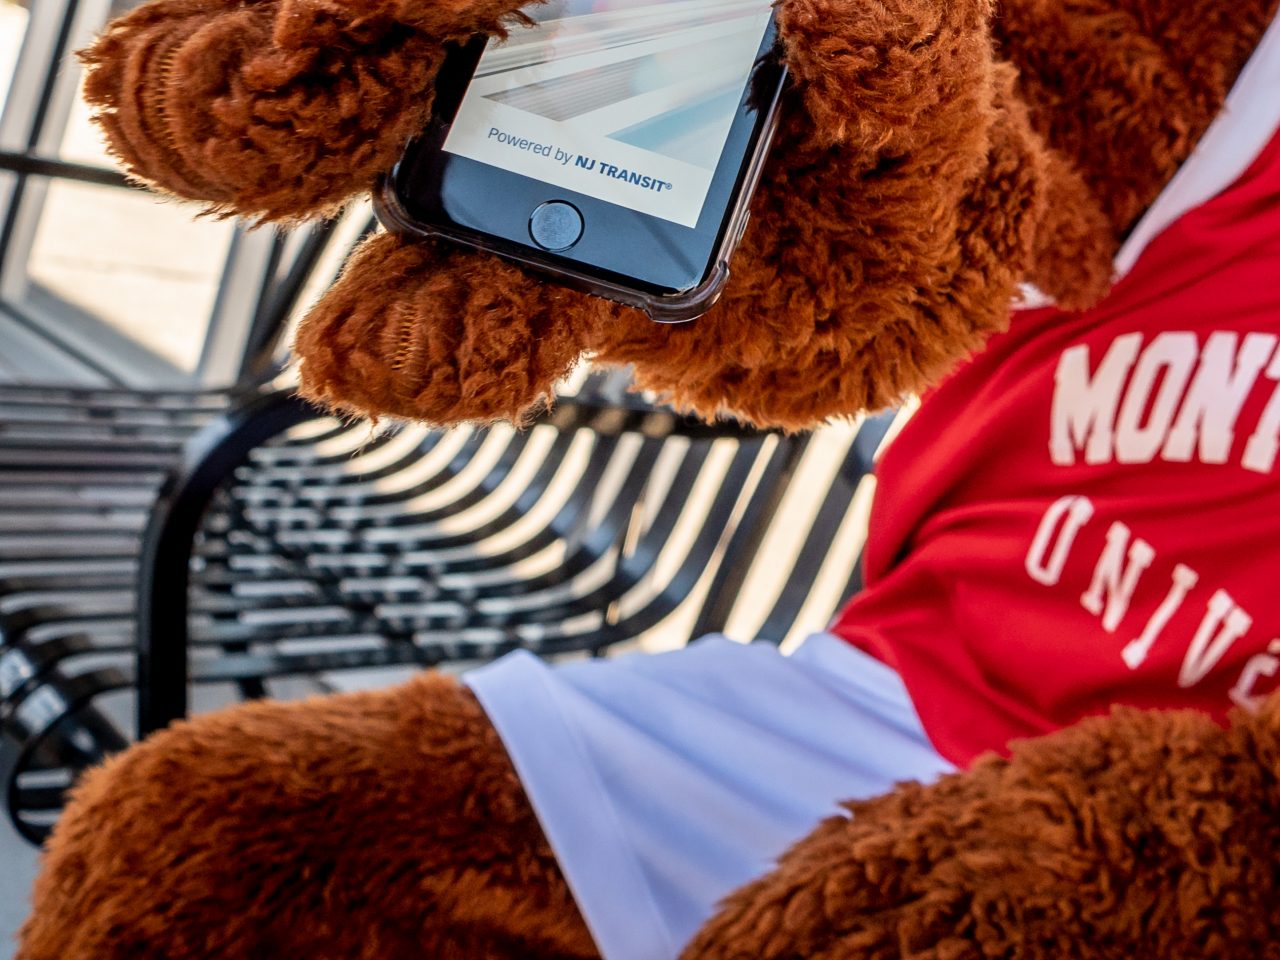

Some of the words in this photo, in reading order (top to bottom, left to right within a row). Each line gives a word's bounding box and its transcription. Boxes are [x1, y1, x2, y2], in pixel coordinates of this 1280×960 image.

[487, 127, 552, 157] Powered
[554, 147, 574, 166] by
[574, 154, 597, 171] NJ
